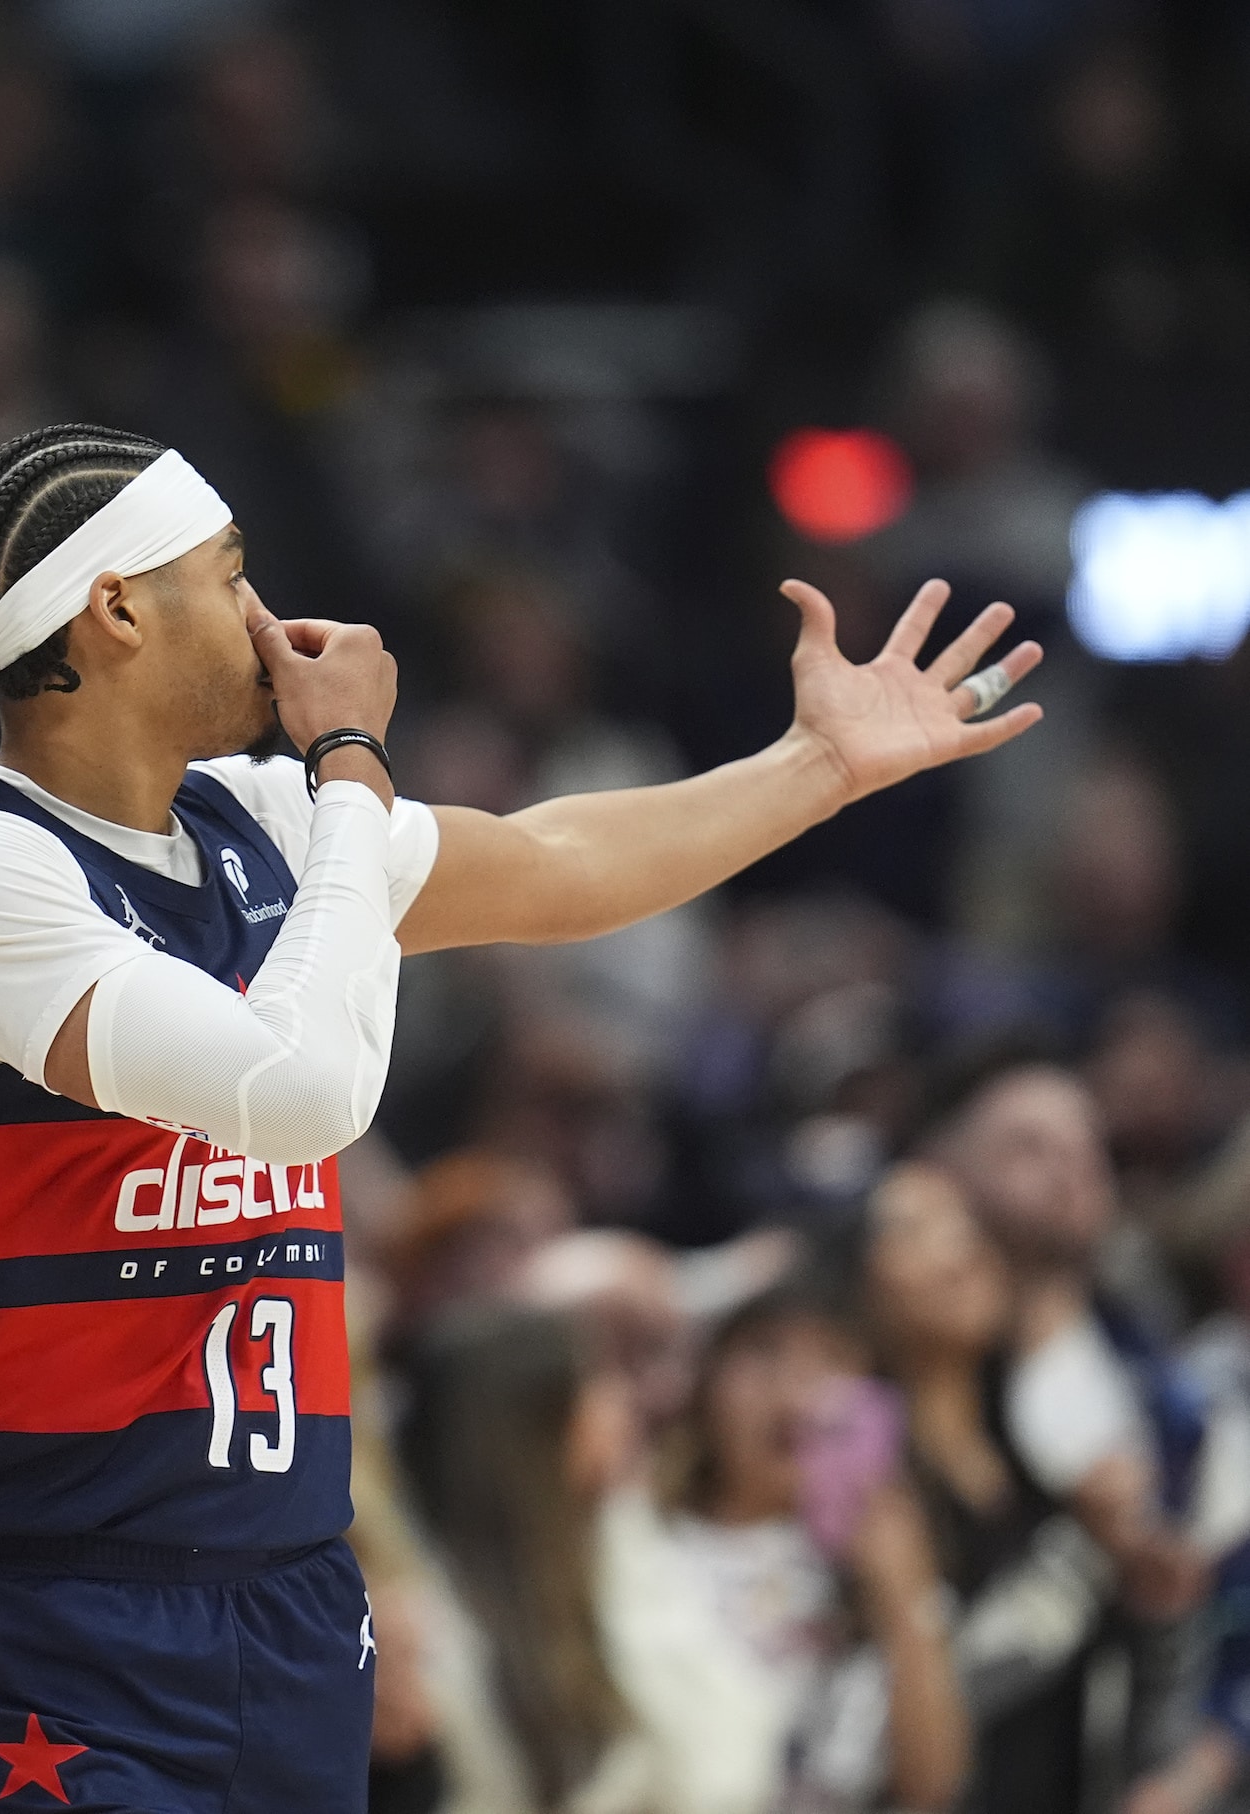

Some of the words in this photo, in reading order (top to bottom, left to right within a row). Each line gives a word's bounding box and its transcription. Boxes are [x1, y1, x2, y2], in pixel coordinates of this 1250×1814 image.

[241, 897, 287, 924] Robinhood
[119, 1261, 168, 1279] OF
[204, 1298, 295, 1474] 13
